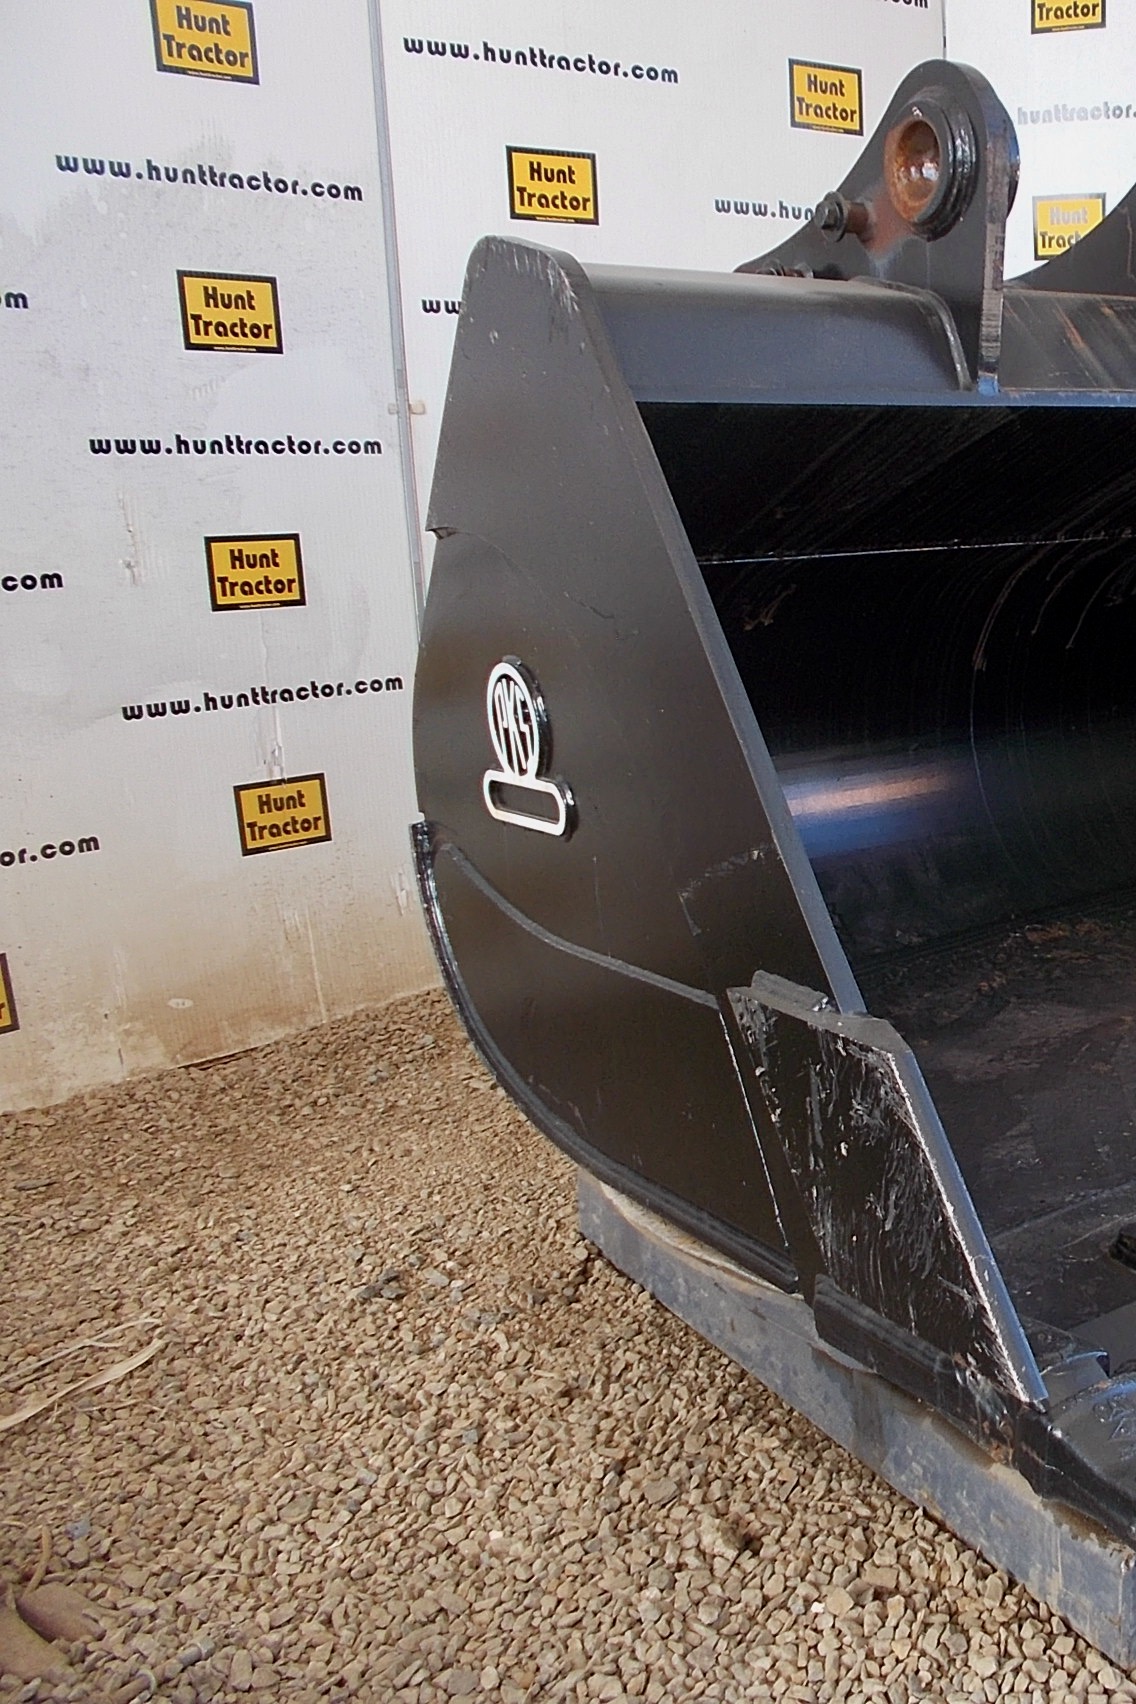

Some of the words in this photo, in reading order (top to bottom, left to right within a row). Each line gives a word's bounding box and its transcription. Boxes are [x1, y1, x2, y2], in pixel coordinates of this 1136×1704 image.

[175, 5, 232, 37] Hunt
[1036, 0, 1100, 21] Tractor
[162, 33, 250, 68] Tractor
[403, 37, 679, 84] www.hunttractor.com
[807, 73, 846, 98] Hunt
[796, 96, 857, 123] Tractor
[55, 154, 363, 202] www.hunttractor.com
[528, 160, 576, 185] Hunt
[516, 185, 591, 212] Tractor
[714, 199, 814, 221] www.hun
[1049, 206, 1089, 225] Hunt
[0, 292, 29, 309] m
[202, 285, 256, 311] Hunt
[189, 313, 273, 340] Tractor
[88, 433, 382, 455] www.hunttractor.com
[229, 548, 280, 570] Hunt
[1, 572, 64, 592] com
[216, 575, 297, 598] Tractor
[121, 677, 403, 721] www.hunttractor.com
[257, 789, 306, 815] Hunt
[246, 815, 322, 842] Tractor
[0, 836, 100, 867] or.com
